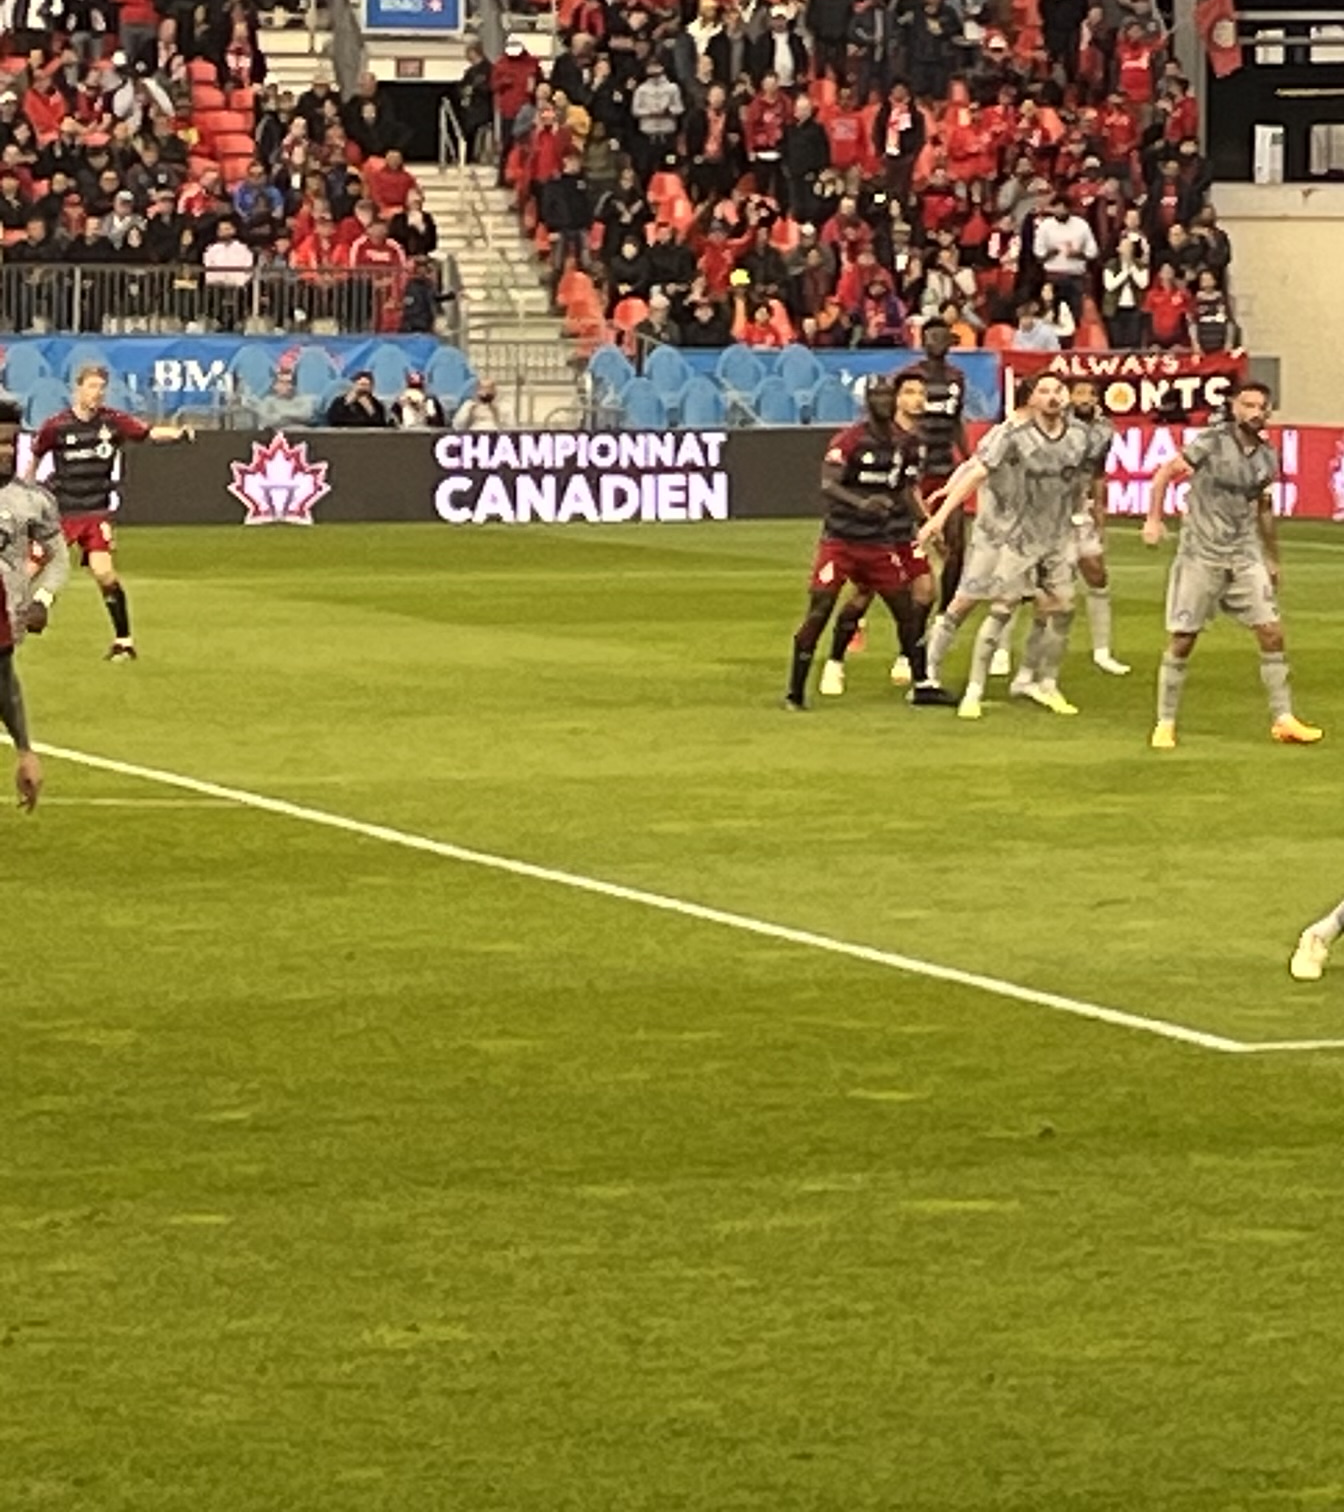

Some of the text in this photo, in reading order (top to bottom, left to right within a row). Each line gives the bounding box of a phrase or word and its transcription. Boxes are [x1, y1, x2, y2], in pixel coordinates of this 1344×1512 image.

[153, 359, 234, 394] BM
[1050, 354, 1179, 375] ALWAYS
[434, 432, 727, 470] CHAMPIONNAT
[434, 471, 728, 522] CANADIEN
